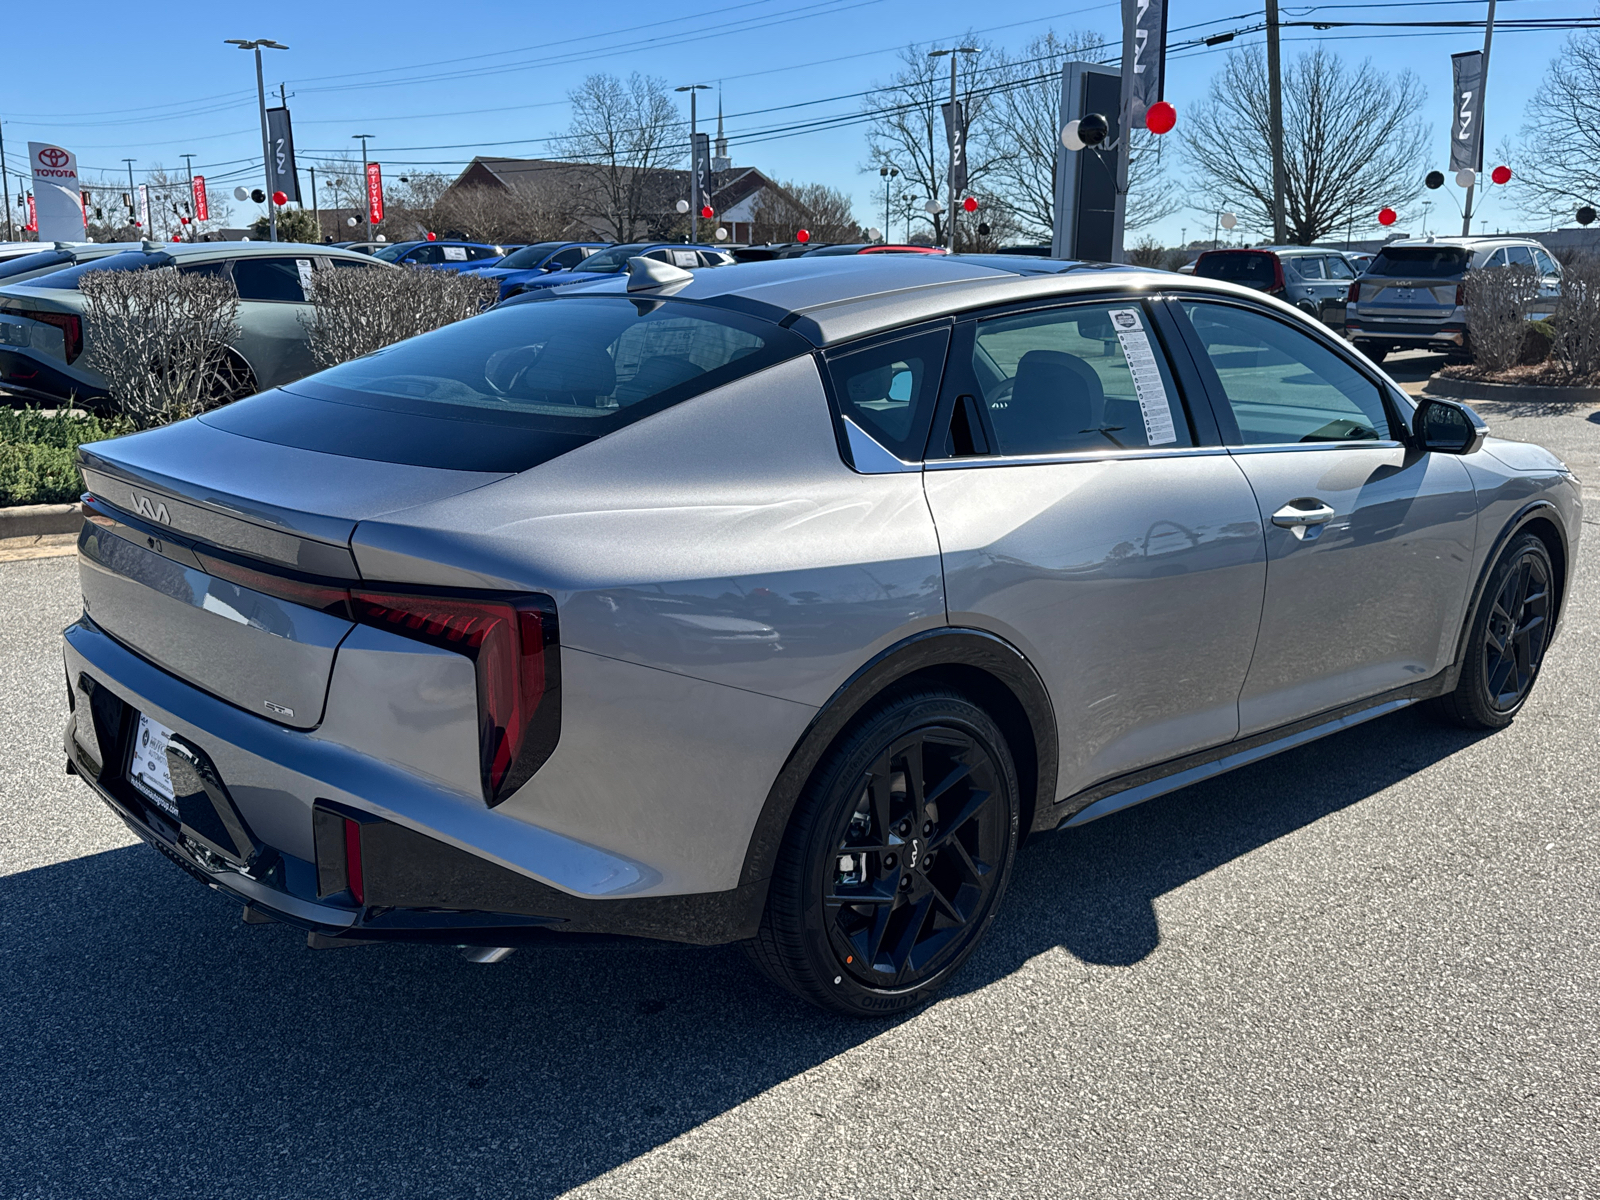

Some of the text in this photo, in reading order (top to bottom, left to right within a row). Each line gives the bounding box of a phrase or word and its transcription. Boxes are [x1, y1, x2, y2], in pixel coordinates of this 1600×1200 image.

[34, 169, 76, 178] TOYOTA
[196, 186, 205, 219] TOYOTA
[370, 176, 379, 217] TOYOTA
[130, 491, 171, 526] KIA
[862, 994, 918, 1009] KUMHO
